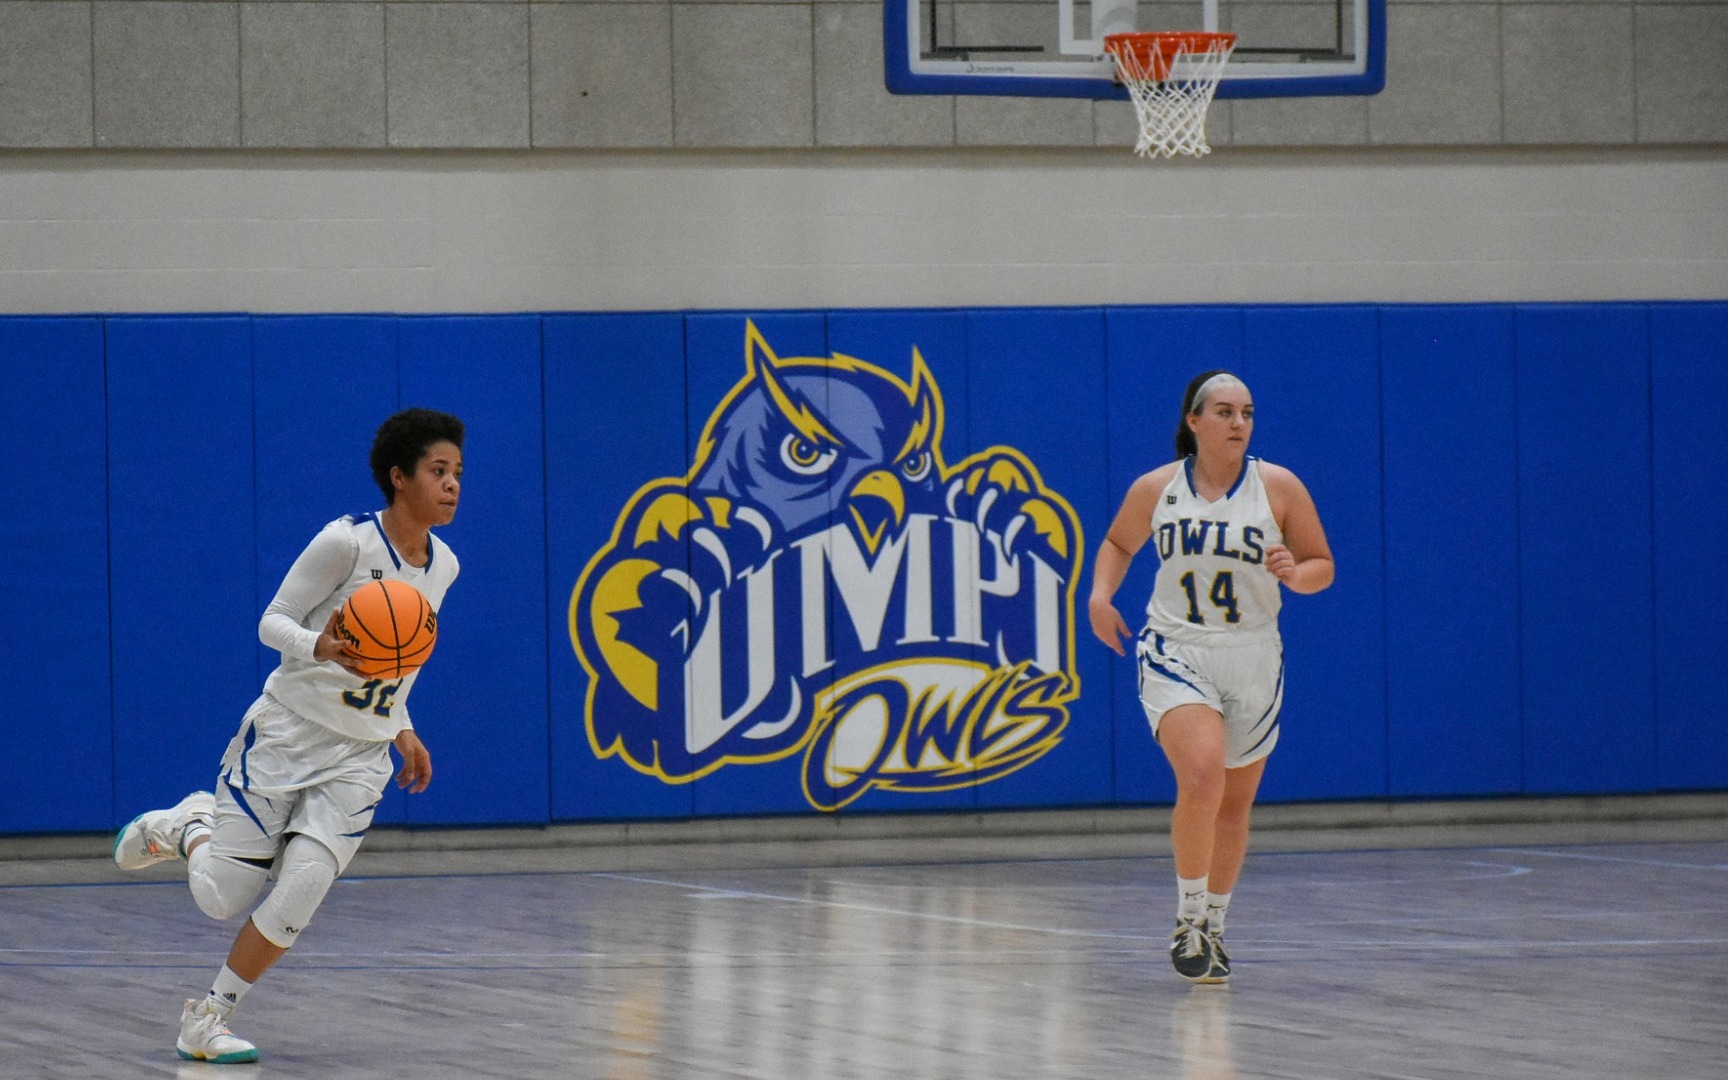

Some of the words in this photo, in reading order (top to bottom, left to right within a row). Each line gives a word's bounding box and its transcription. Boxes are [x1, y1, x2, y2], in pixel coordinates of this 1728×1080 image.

[1158, 518, 1265, 565] OWLS
[1180, 571, 1241, 625] 14
[684, 513, 1065, 755] UMPI
